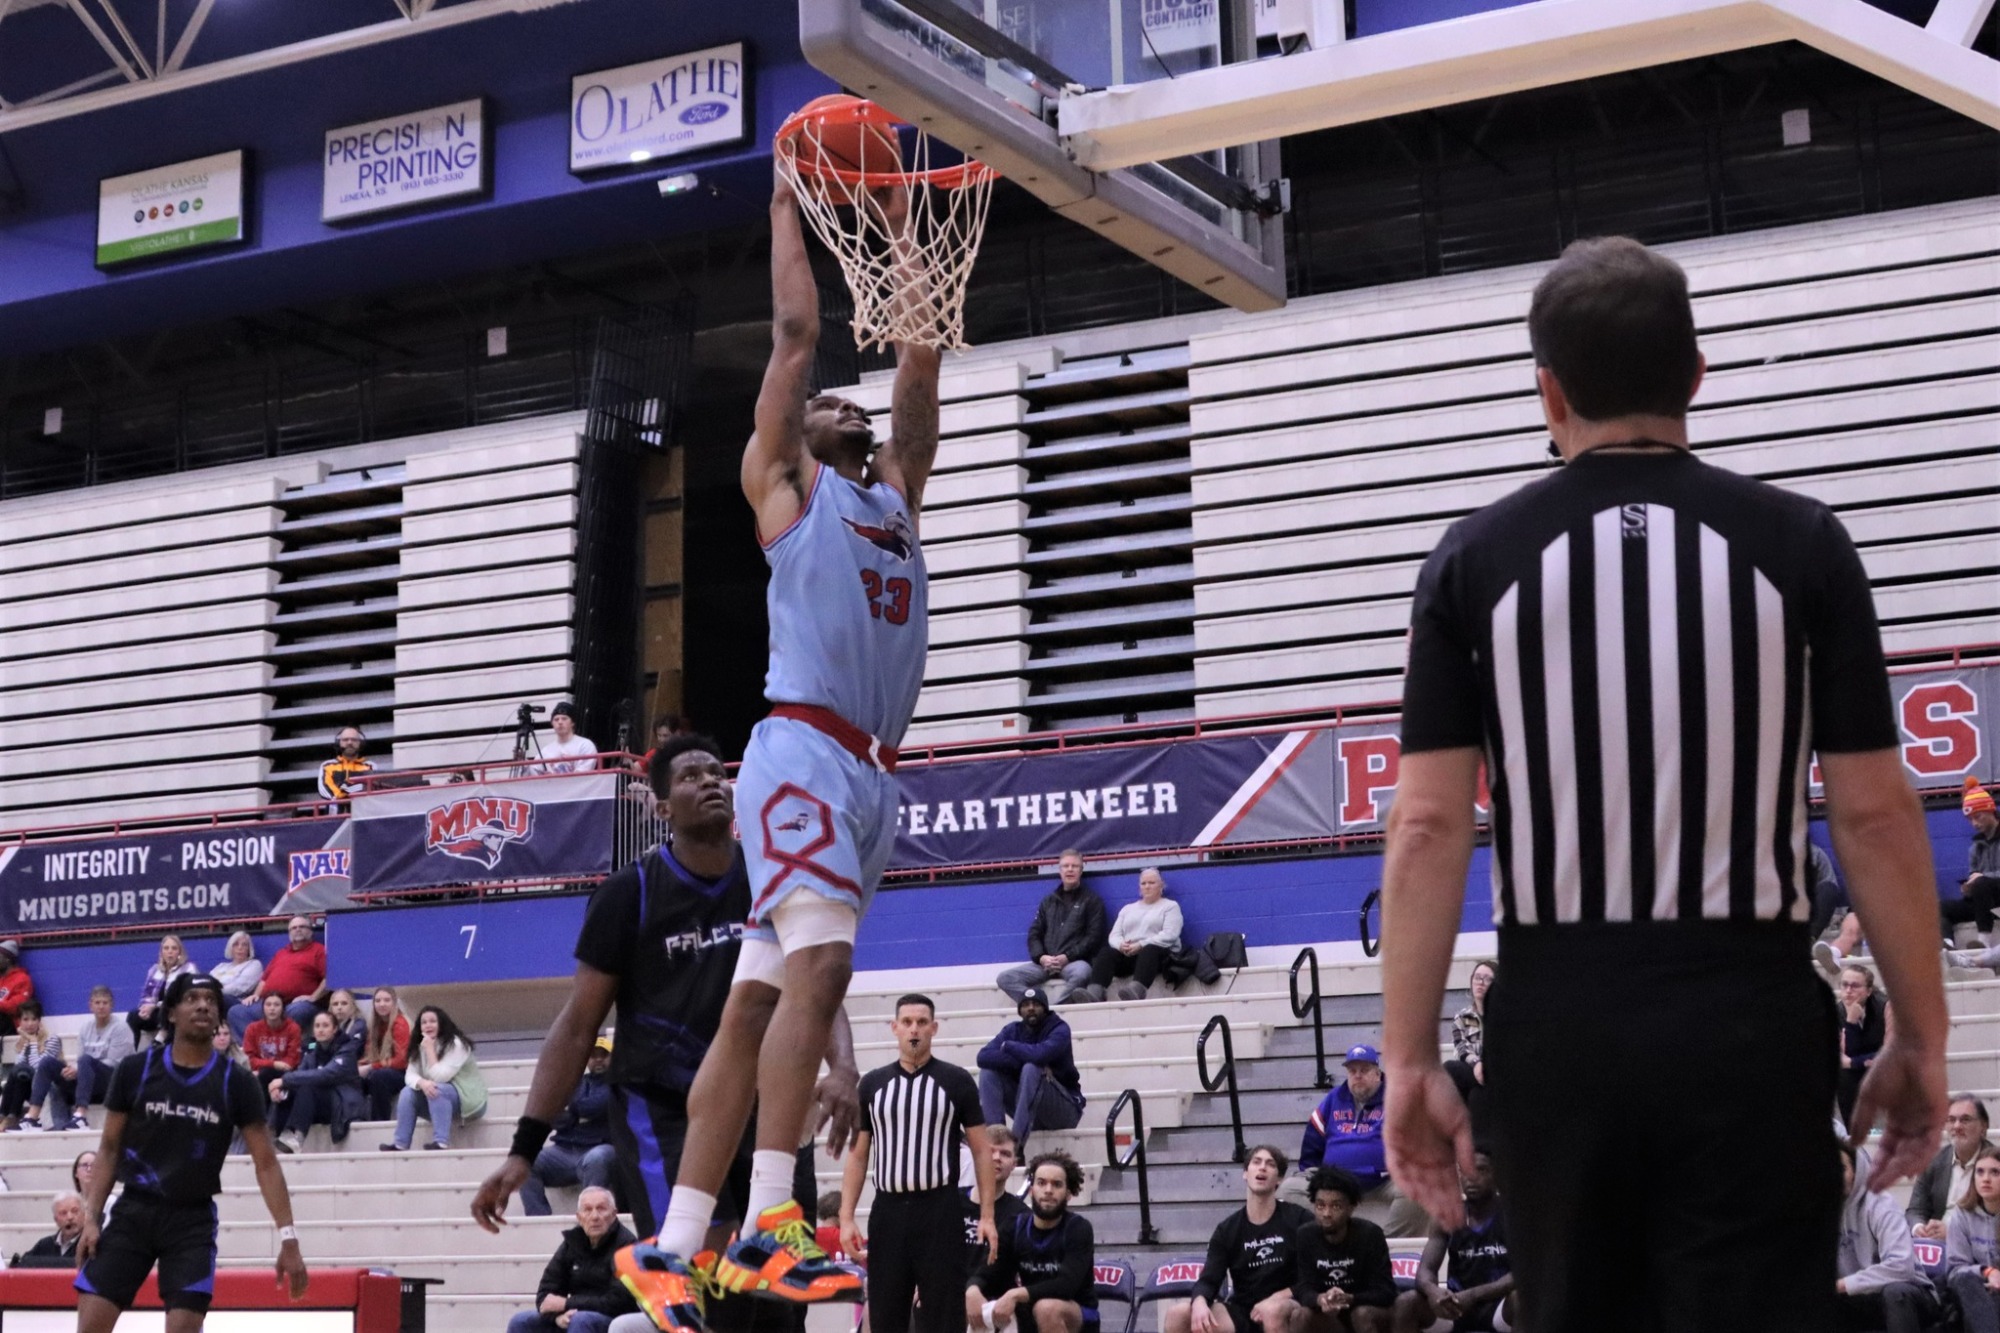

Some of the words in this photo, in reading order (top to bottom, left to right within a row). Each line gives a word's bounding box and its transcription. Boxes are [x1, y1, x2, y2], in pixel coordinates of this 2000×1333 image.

[575, 58, 740, 142] OLATHE
[688, 105, 719, 123] Ford
[328, 113, 465, 166] PRECISION
[171, 173, 209, 189] KANSAS
[359, 142, 477, 189] PRINTING
[860, 567, 912, 626] 23
[427, 797, 531, 849] MNU
[44, 846, 150, 882] INTEGRITY
[181, 835, 275, 871] PASSION
[288, 849, 350, 893] NAI
[18, 883, 230, 922] MNUSPORTS.COM
[460, 925, 477, 959] 7
[665, 923, 746, 959] FALCO
[145, 1097, 219, 1125] FALCONS
[1156, 1262, 1206, 1286] MN
